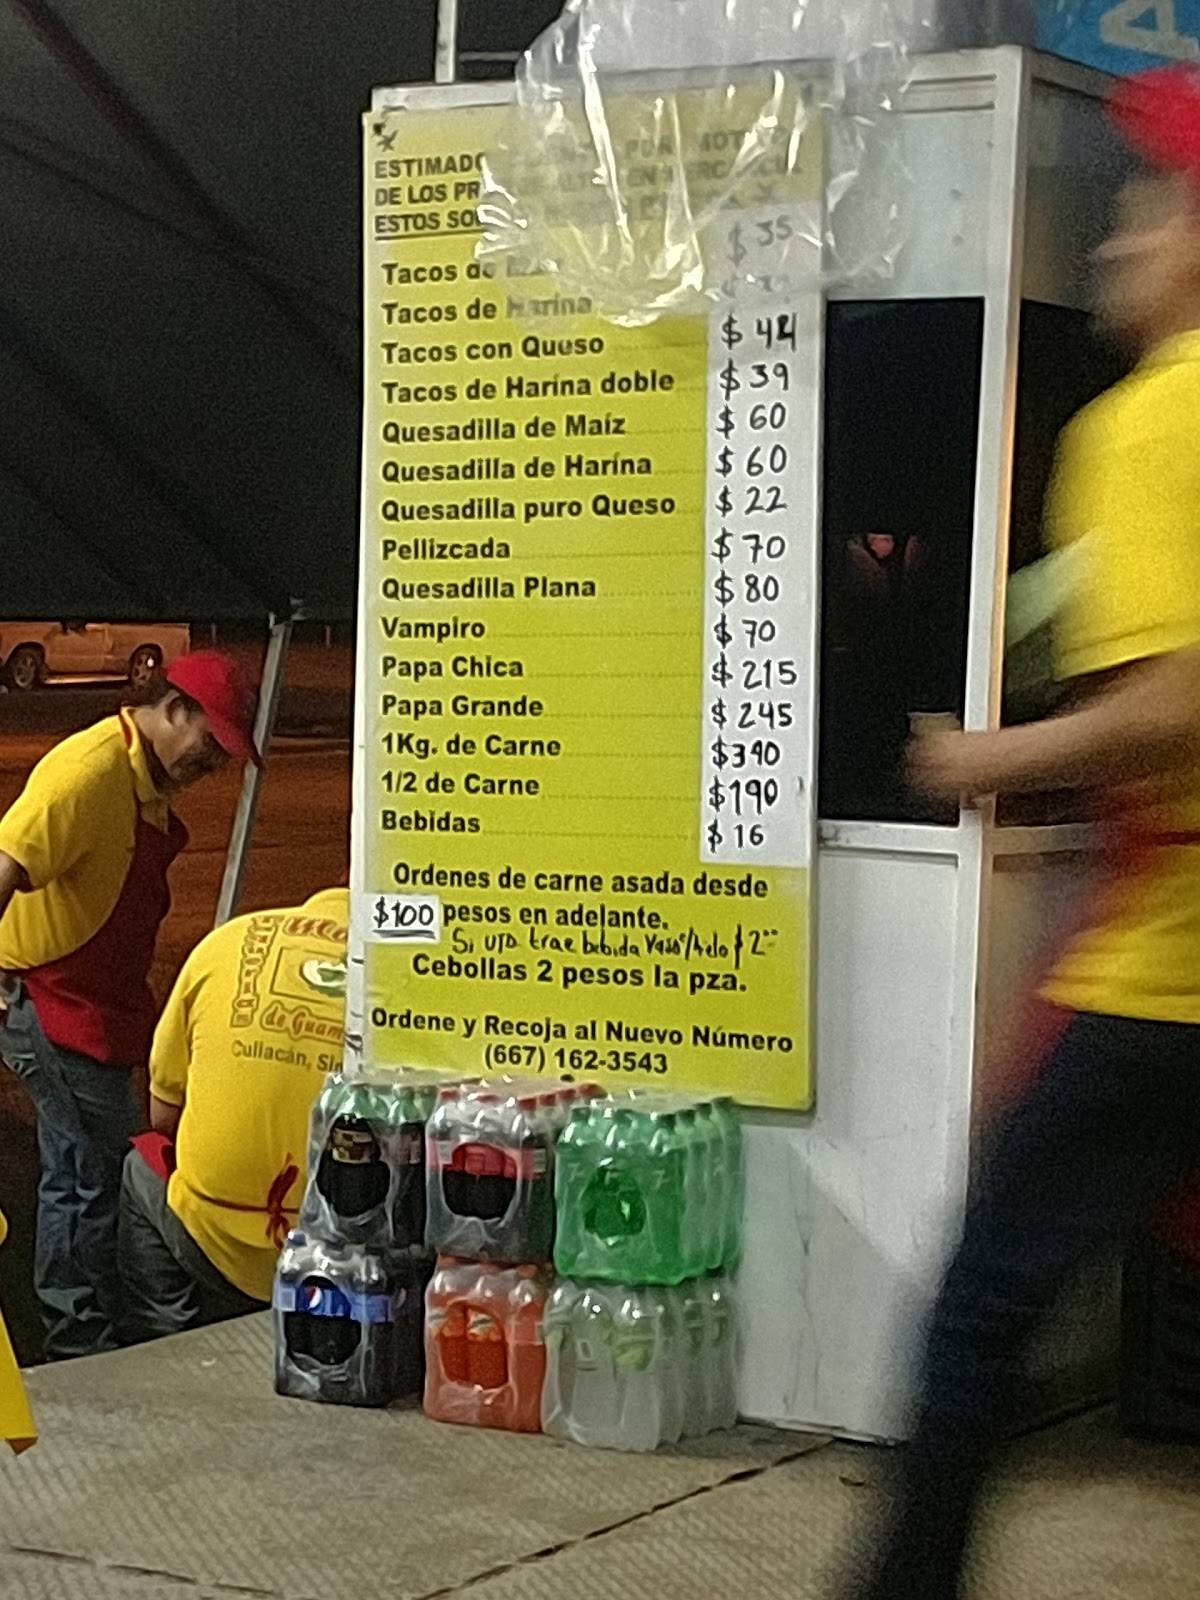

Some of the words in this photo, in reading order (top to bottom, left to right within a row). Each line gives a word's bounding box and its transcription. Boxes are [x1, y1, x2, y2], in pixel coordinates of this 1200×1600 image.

[374, 186, 403, 207] DE
[407, 183, 448, 205] LOS
[374, 215, 441, 235] ESTOS
[380, 262, 458, 286] Tacos
[381, 302, 458, 325] Tacos
[466, 297, 497, 320] de
[721, 312, 743, 351] $
[380, 342, 458, 365] Tacos
[466, 342, 513, 360] con
[521, 335, 604, 358] Queso
[381, 381, 458, 404] Tacos
[465, 378, 497, 401] de
[600, 370, 675, 394] doble
[719, 357, 741, 402] $
[749, 362, 789, 391] 39
[382, 417, 516, 445] Quesadilla
[524, 415, 556, 438] de
[565, 412, 627, 437] Maíz
[715, 404, 735, 440] $
[749, 401, 787, 431] 60
[382, 457, 516, 483] Quesadilla
[524, 456, 556, 478] de
[715, 445, 734, 478] $
[746, 443, 788, 477] 60
[381, 497, 515, 522] Quesadilla
[524, 500, 583, 524] puro
[591, 494, 676, 518] Queso
[715, 485, 733, 518] $
[744, 486, 788, 516] 22
[382, 536, 511, 561] Pellizcada
[710, 526, 734, 564] $
[741, 533, 786, 565] 70
[382, 576, 515, 601] Quesadilla
[524, 575, 596, 598] Plana
[714, 569, 735, 609] $
[744, 573, 780, 603] 80
[381, 615, 486, 644] Vampiro
[713, 612, 733, 650] $
[741, 619, 776, 649] 70
[382, 656, 443, 683] Papa
[451, 655, 524, 678] Chica
[711, 651, 734, 689] $
[742, 658, 798, 690] 215
[382, 694, 443, 721] Papa
[451, 694, 544, 717] Grande
[711, 696, 728, 730] $
[737, 701, 793, 730] 245
[381, 732, 438, 760] 1Kg.
[446, 732, 477, 755] de
[485, 734, 561, 757] Carne
[381, 770, 418, 793] 1/2
[425, 771, 456, 794] de
[464, 773, 540, 796] Carne
[708, 775, 778, 816] $190
[381, 809, 481, 833] Bebidas
[734, 823, 764, 849] 16
[393, 862, 490, 889] Ordenes
[498, 865, 526, 890] de
[534, 872, 603, 893] carne
[611, 870, 685, 895] asada
[693, 871, 769, 898] desde
[373, 896, 435, 930] $100
[442, 903, 512, 927] pesos
[519, 907, 548, 926] en
[556, 904, 669, 930] adelante.
[412, 954, 528, 981] Cebollas
[537, 959, 554, 983] 2
[562, 966, 644, 990] pesos
[654, 964, 679, 989] la
[689, 972, 747, 996] pza.
[264, 1008, 285, 1028] de
[371, 1007, 456, 1032] Ordene
[462, 1017, 477, 1039] y
[484, 1014, 567, 1044] Recoja
[574, 1019, 597, 1041] al
[606, 1020, 683, 1046] Nuevo
[692, 1025, 793, 1053] Número
[484, 1043, 546, 1073] (667)
[554, 1047, 668, 1074] 162-3543
